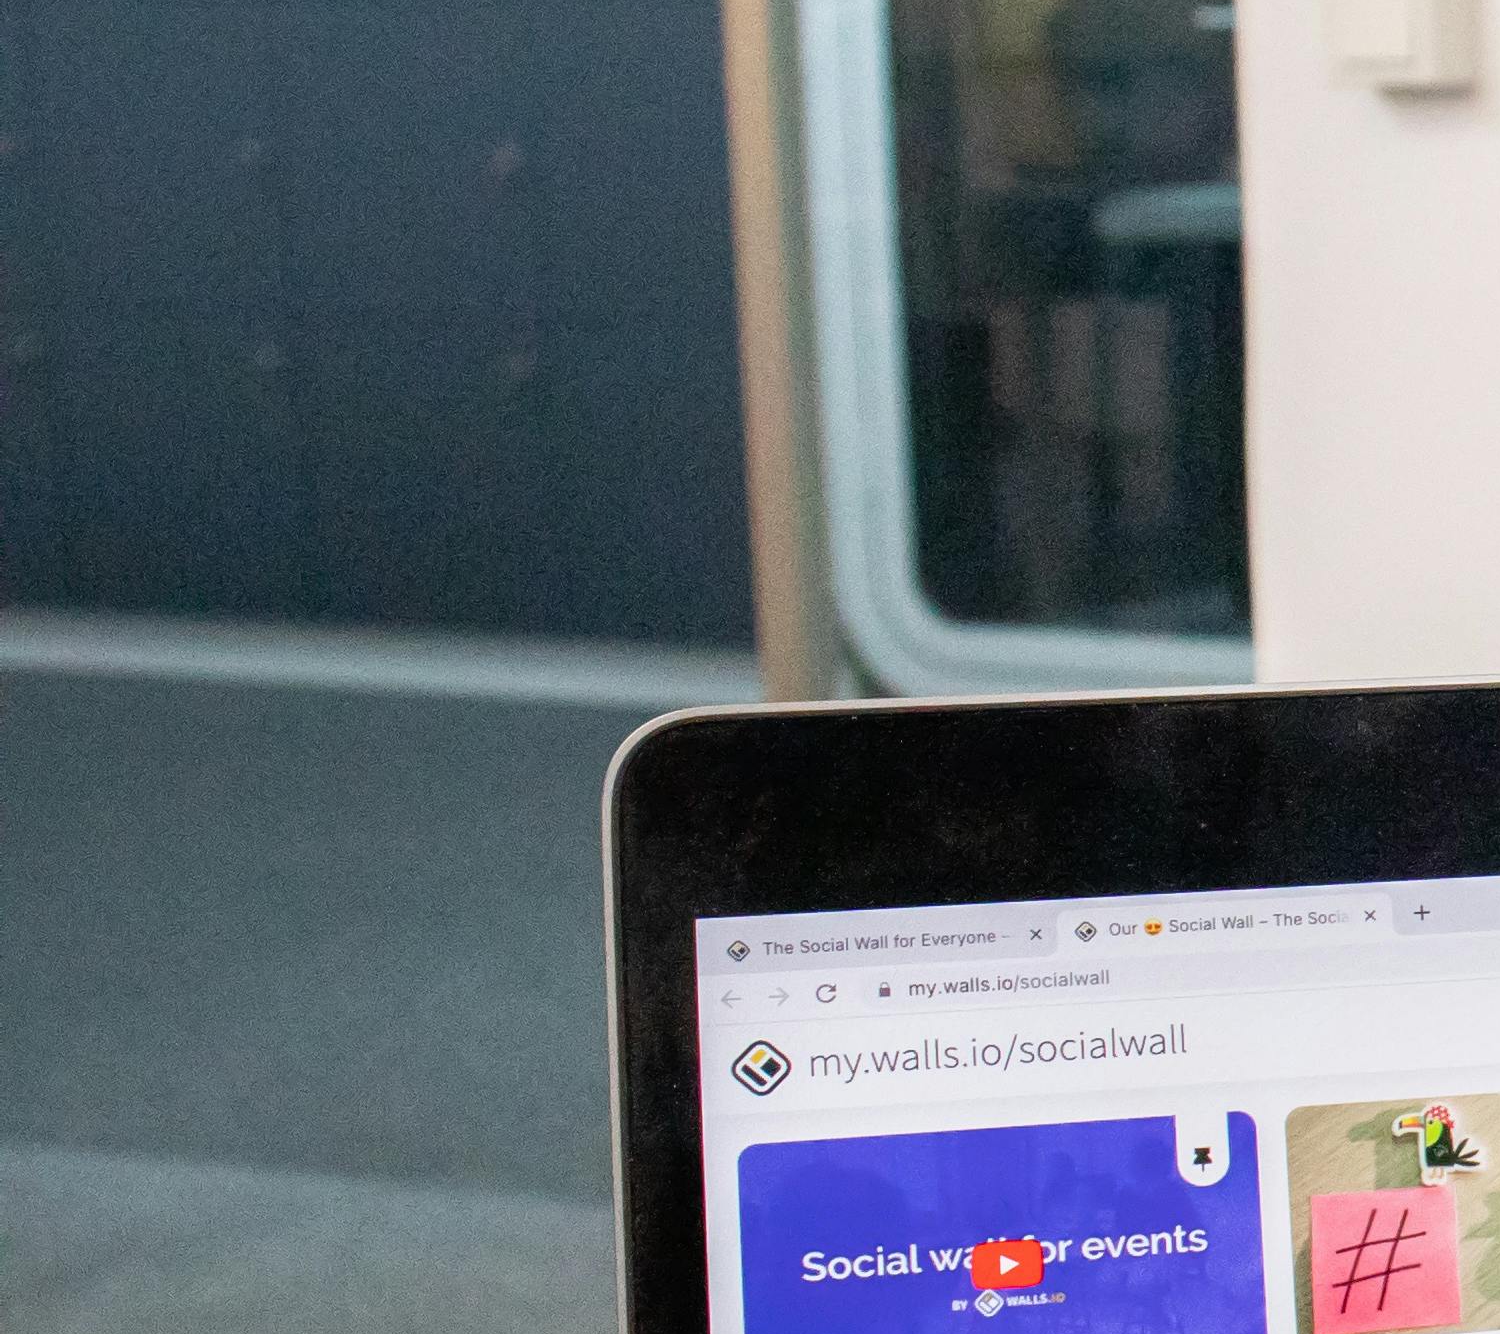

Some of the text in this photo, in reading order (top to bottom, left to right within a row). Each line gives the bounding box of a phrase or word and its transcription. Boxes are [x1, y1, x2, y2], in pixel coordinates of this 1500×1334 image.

[1108, 922, 1138, 937] Our
[1168, 917, 1217, 933] Social
[1221, 914, 1254, 930] Wall
[1272, 913, 1303, 927] The
[762, 932, 997, 956] The Social Wall for Everyone
[908, 969, 1110, 999] my.walls.io/socialwall
[810, 1023, 1187, 1084] my.walls.io/socialwall
[802, 1244, 922, 1282] Social
[1081, 1224, 1209, 1261] events
[951, 1299, 968, 1312] BY
